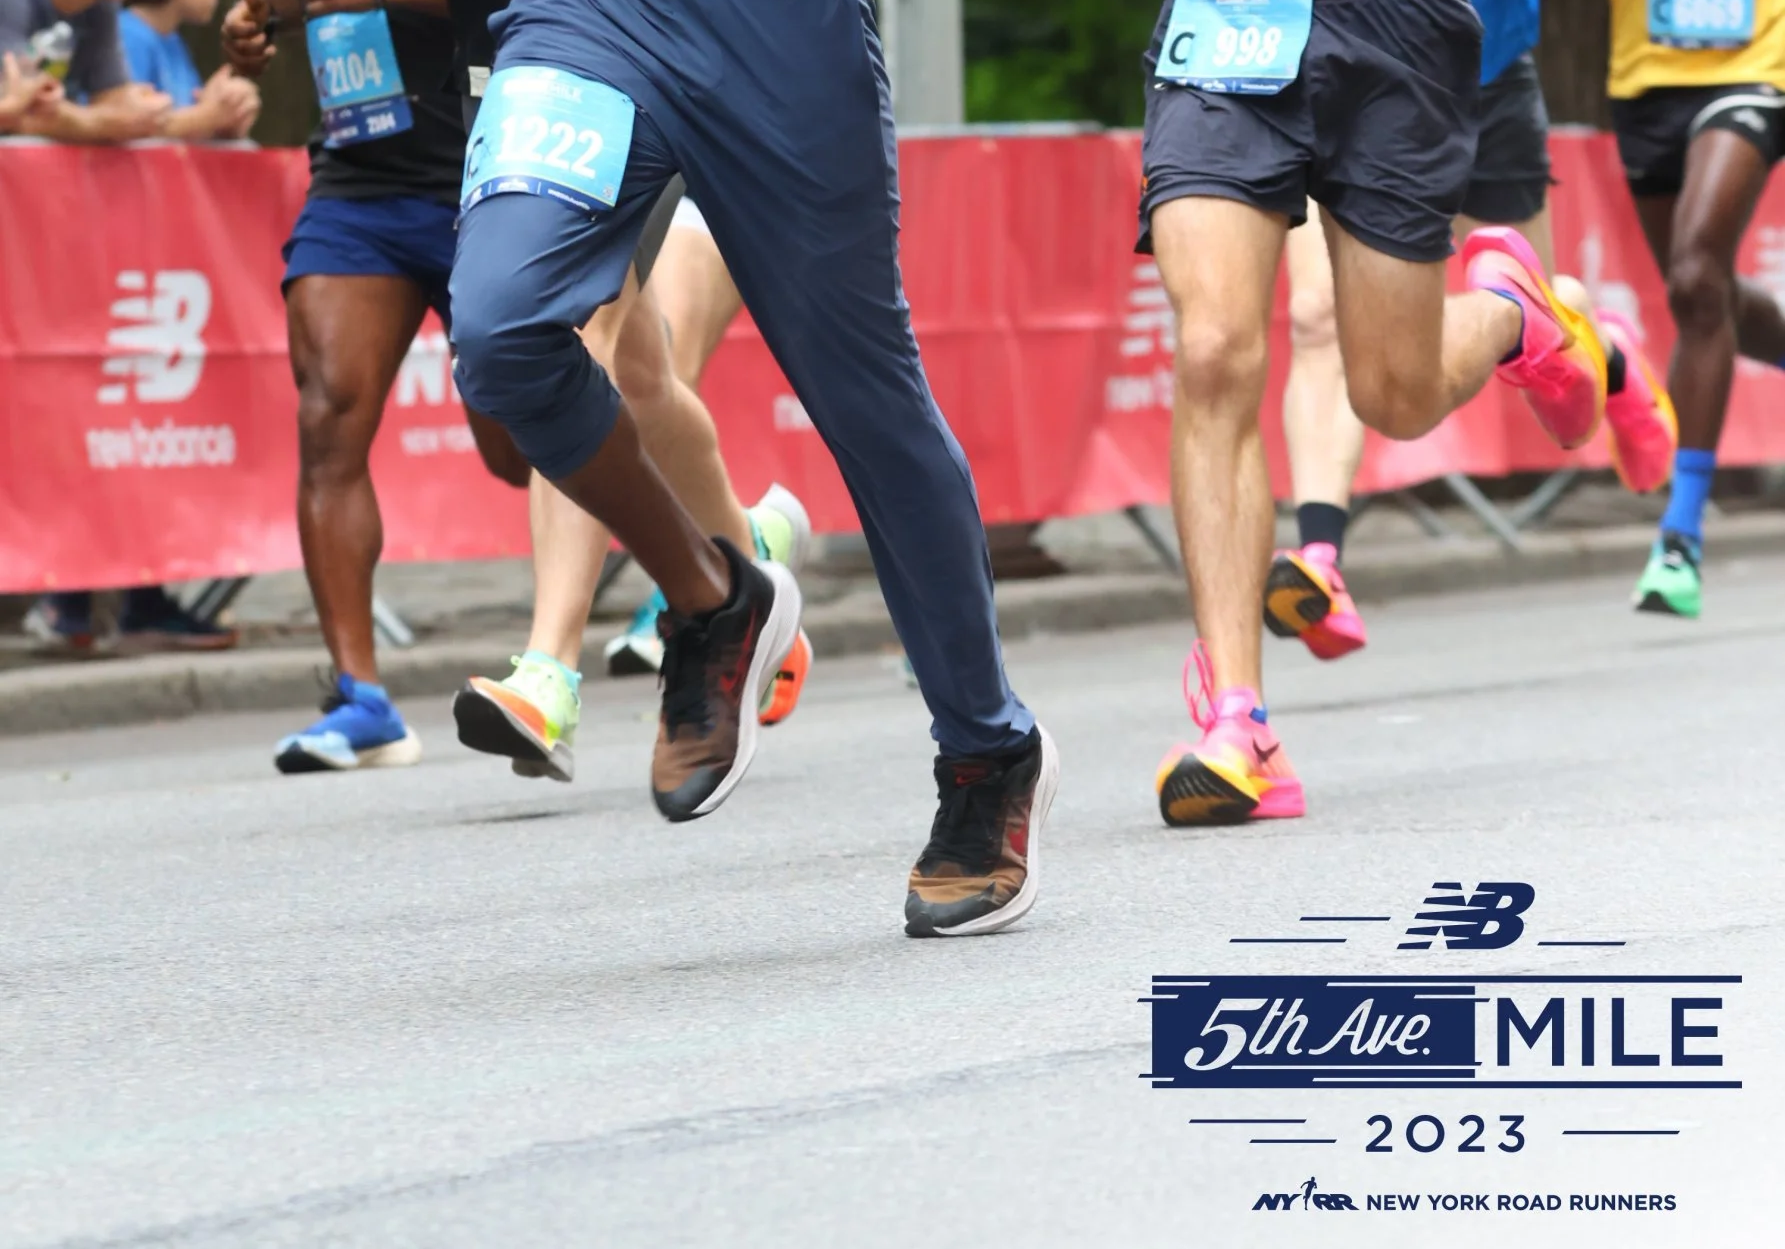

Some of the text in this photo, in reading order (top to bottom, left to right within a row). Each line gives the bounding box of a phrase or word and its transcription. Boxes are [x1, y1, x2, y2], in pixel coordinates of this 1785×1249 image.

[1169, 26, 1282, 68] C 998
[326, 48, 383, 97] 2104
[494, 115, 603, 180] 1222
